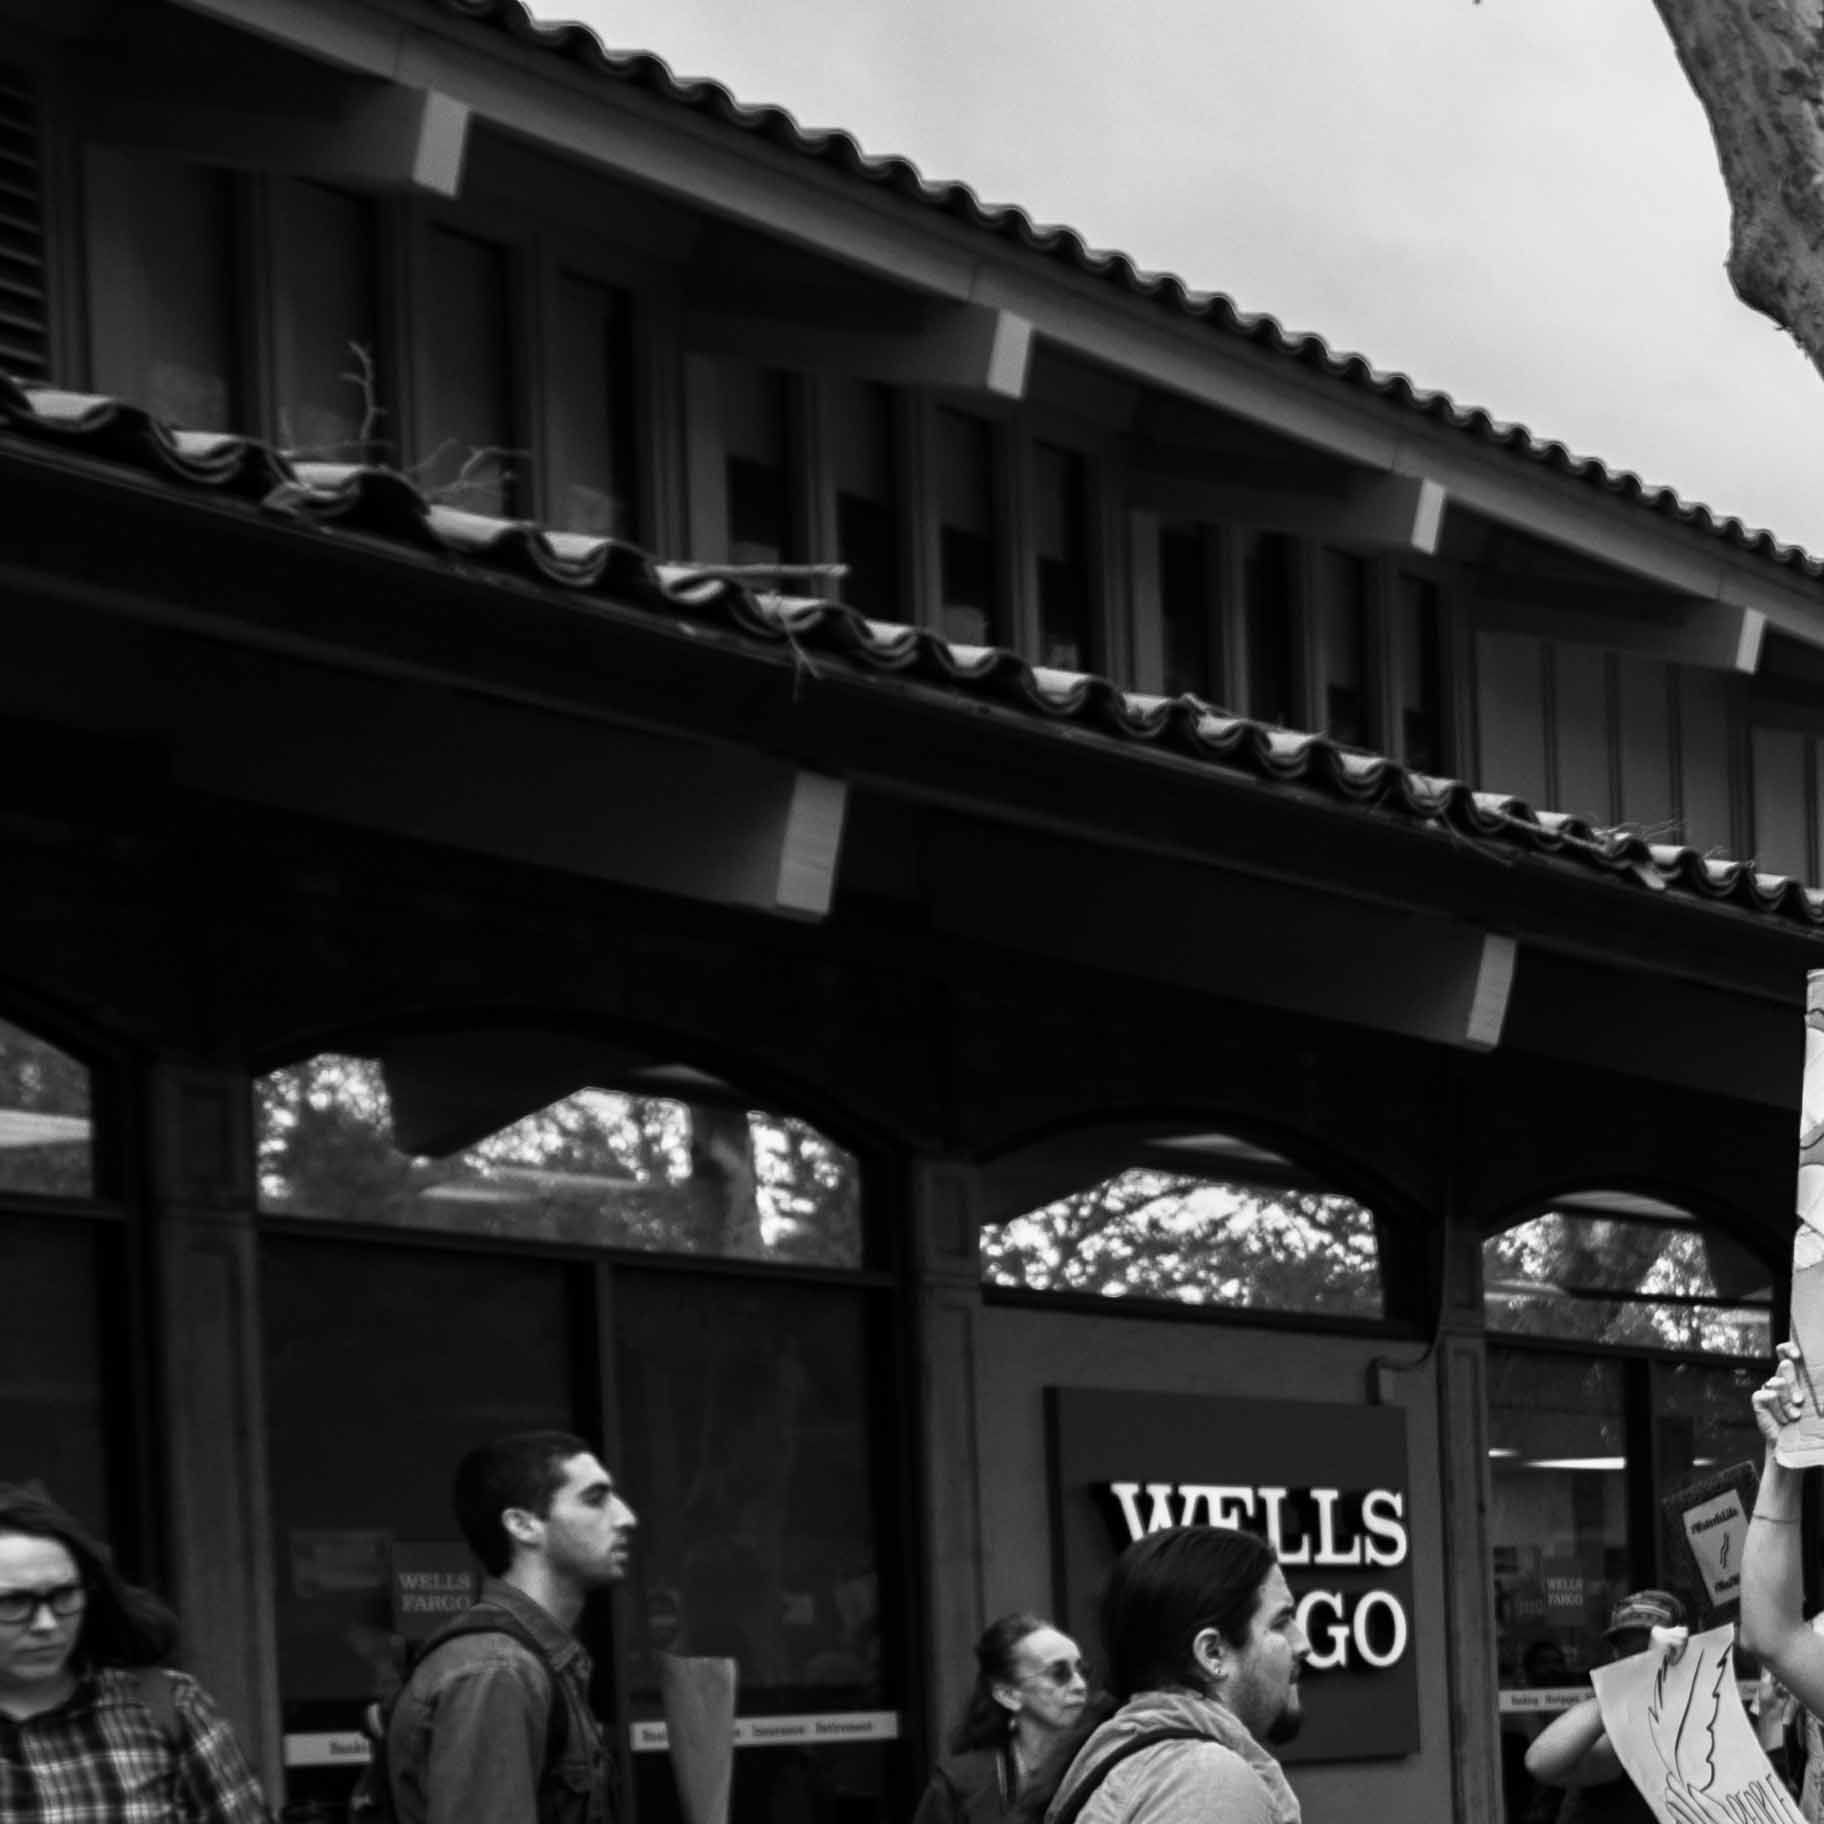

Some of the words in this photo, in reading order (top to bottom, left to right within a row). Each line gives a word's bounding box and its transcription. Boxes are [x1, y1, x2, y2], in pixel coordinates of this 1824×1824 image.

[1111, 1482, 1408, 1567] WELLS
[399, 1572, 471, 1590] WELLS
[401, 1593, 473, 1612] FARGO
